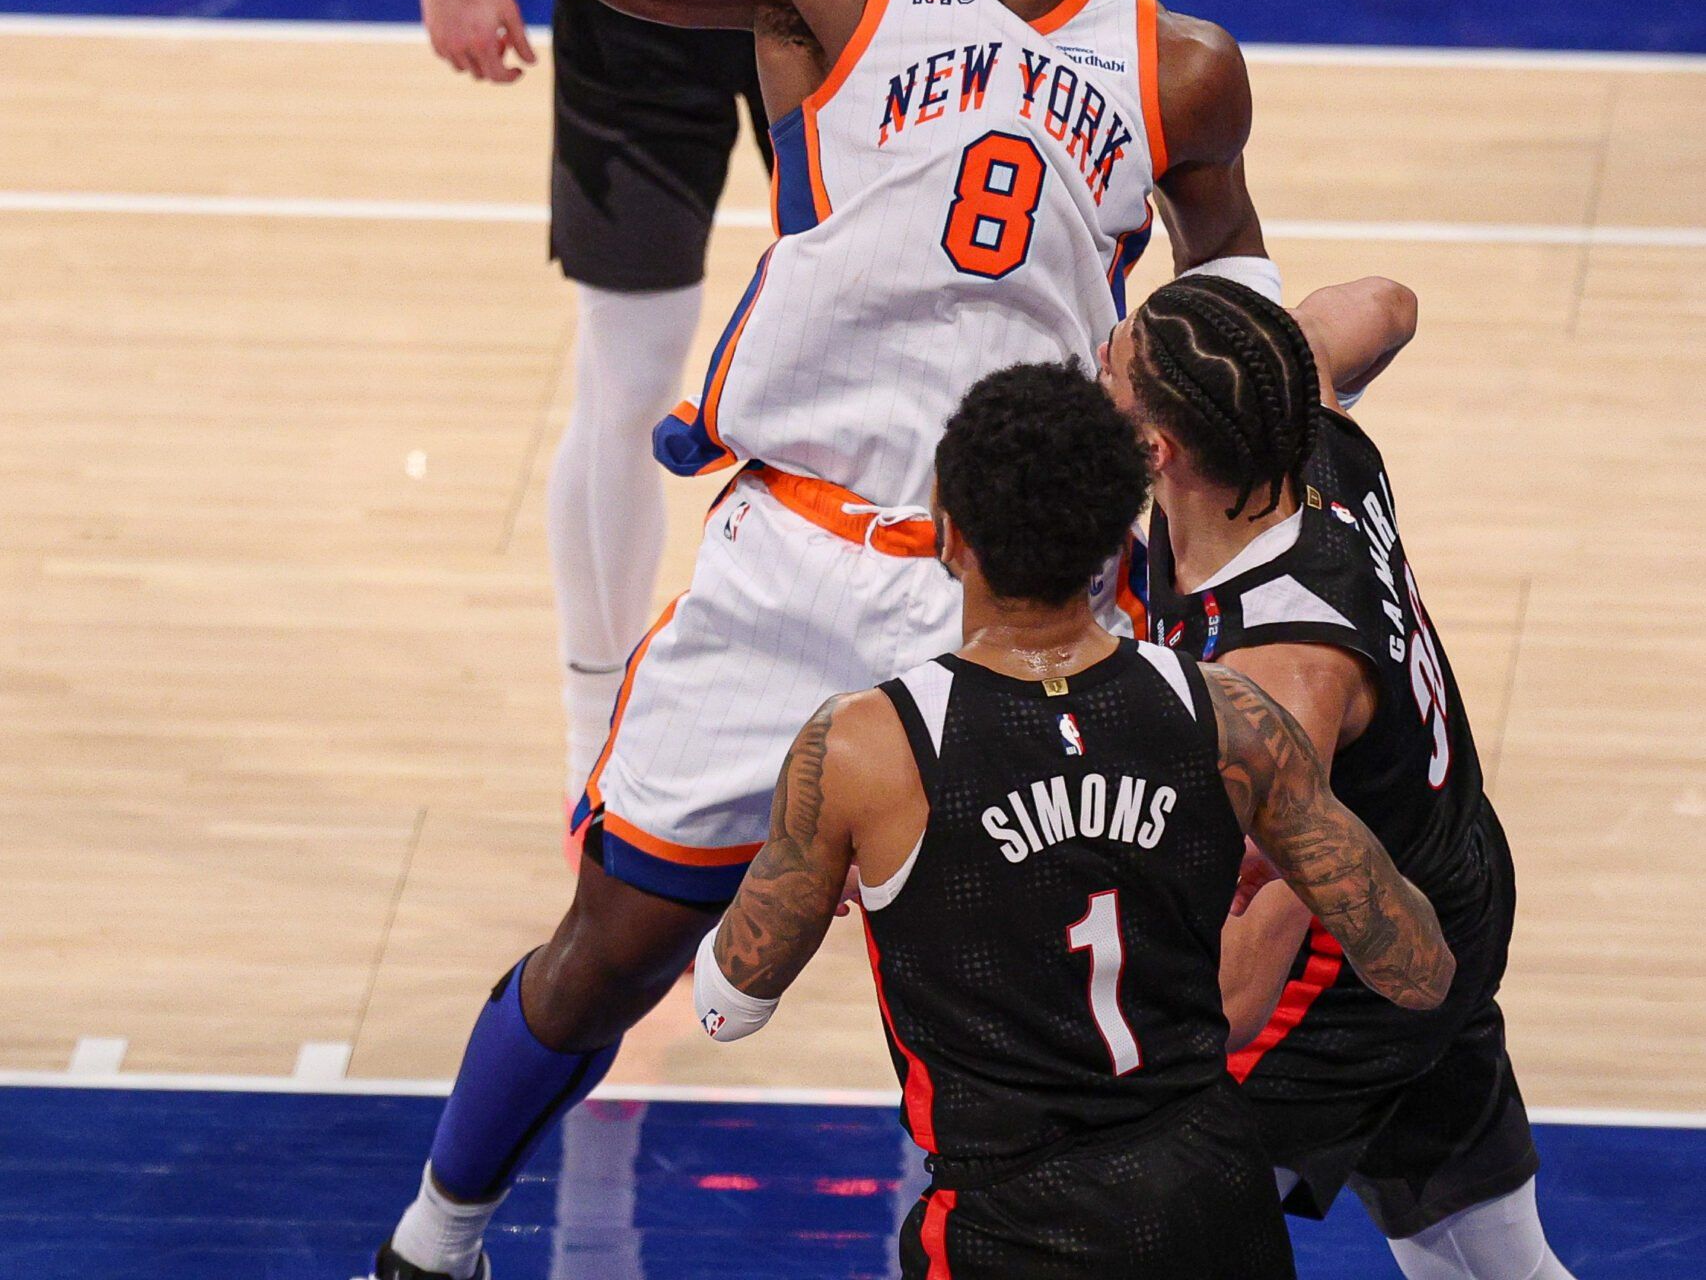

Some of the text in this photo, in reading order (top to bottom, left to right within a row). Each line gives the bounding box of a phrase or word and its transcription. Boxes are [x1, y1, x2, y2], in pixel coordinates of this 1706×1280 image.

[878, 42, 1132, 207] NEW YORK
[1085, 55, 1125, 72] dhabi
[941, 130, 1047, 280] 8
[981, 773, 1177, 864] SIMONS
[1067, 889, 1142, 1077] 1
